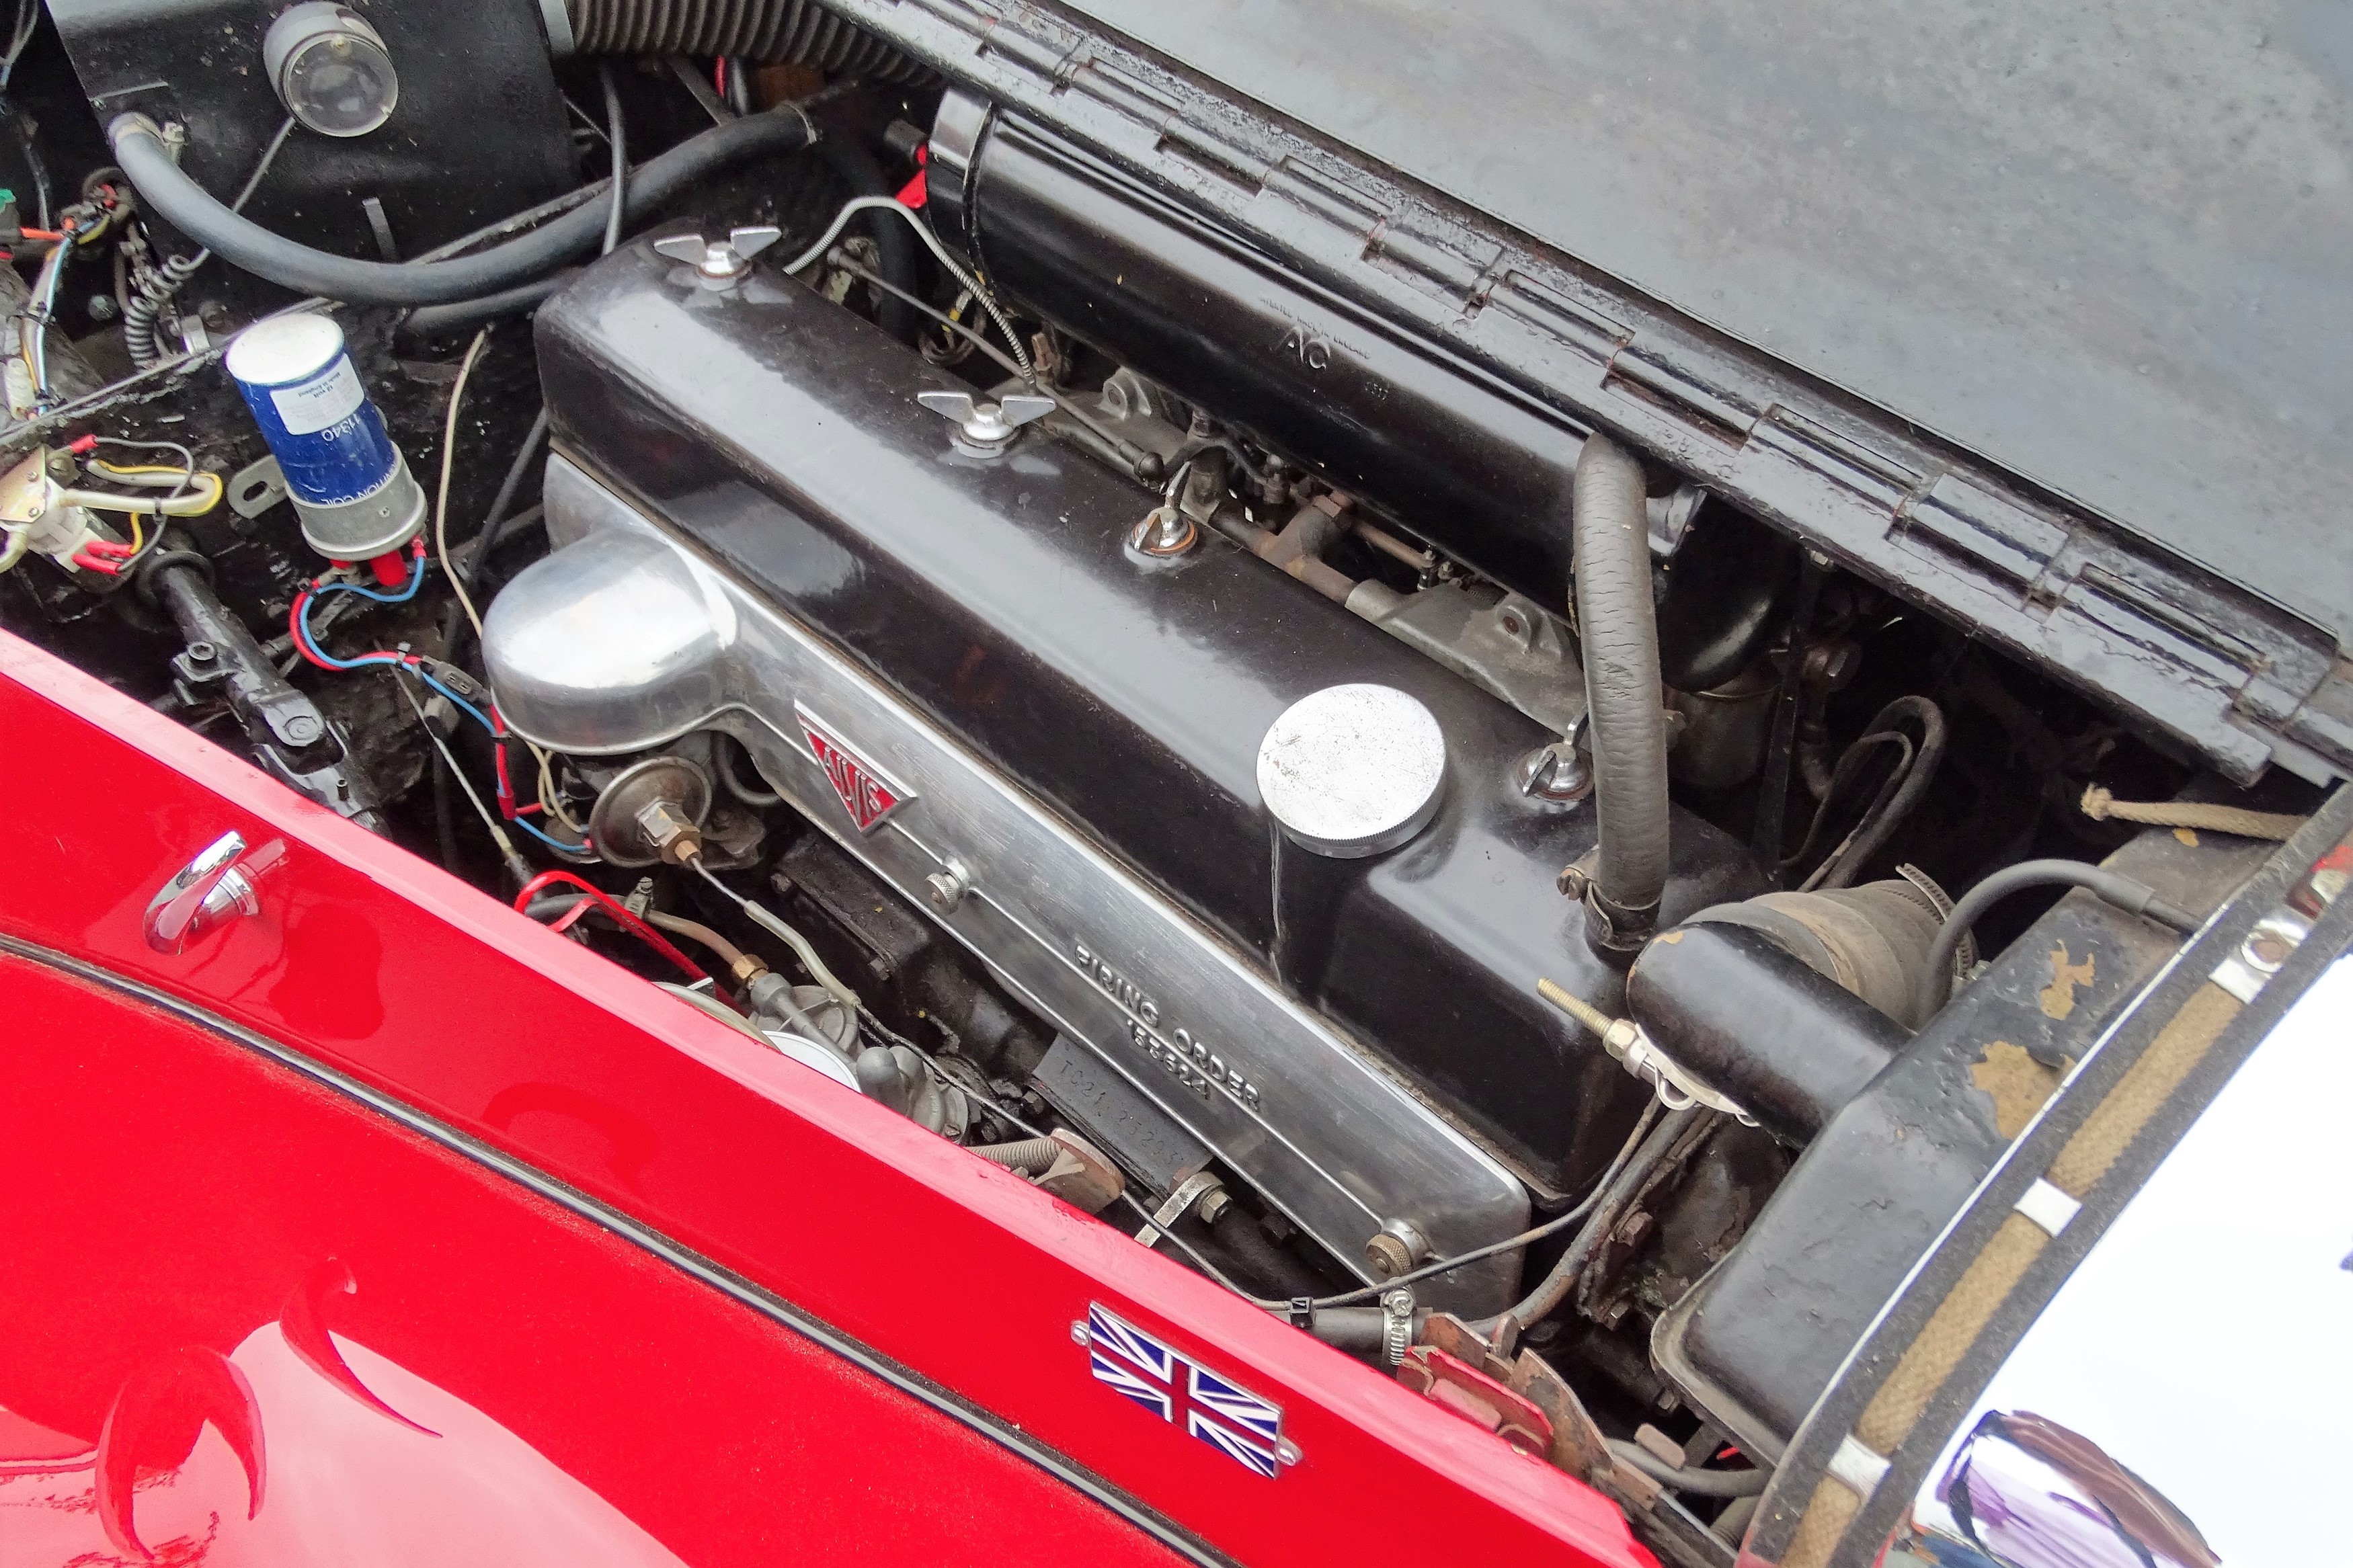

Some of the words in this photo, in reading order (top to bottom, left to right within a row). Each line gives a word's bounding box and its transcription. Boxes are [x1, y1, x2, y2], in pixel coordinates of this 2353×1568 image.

[1269, 325, 1330, 370] AC
[824, 745, 882, 827] ALVIS
[1076, 945, 1159, 1027] FIRING
[1173, 1028, 1261, 1111] ORDER
[1127, 1019, 1209, 1100] 153624
